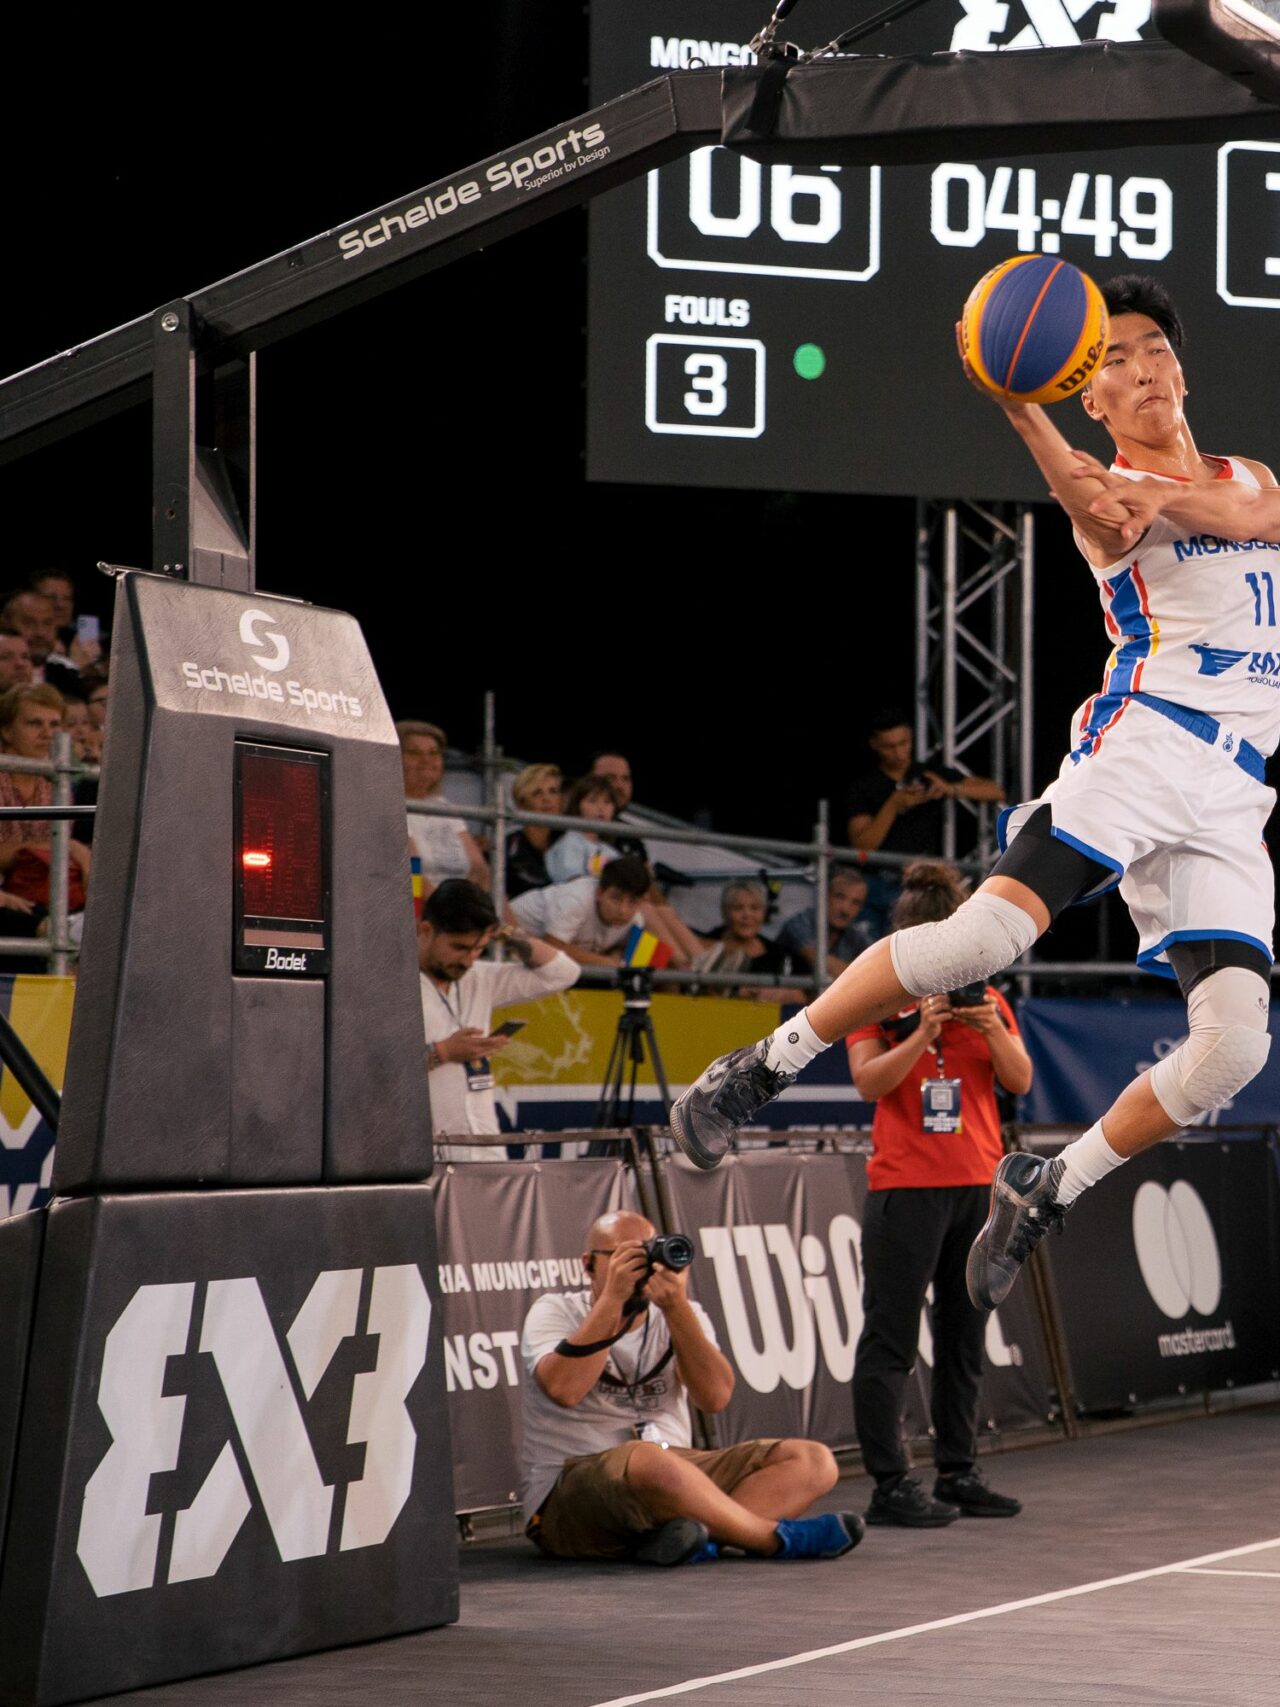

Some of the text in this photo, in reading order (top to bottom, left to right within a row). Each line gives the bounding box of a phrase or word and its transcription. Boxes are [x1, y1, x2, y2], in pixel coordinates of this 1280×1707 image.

[650, 36, 758, 69] MONGO
[338, 123, 606, 260] Schelde Sports
[524, 167, 564, 191] Superior
[577, 146, 611, 167] Design
[930, 162, 1173, 261] 04:49
[665, 294, 750, 328] FOULS
[683, 353, 728, 416] 3
[1244, 571, 1277, 627] 11
[182, 661, 363, 717] Schelde Sports
[264, 947, 307, 971] Bodet
[1158, 1320, 1236, 1358] mastercard
